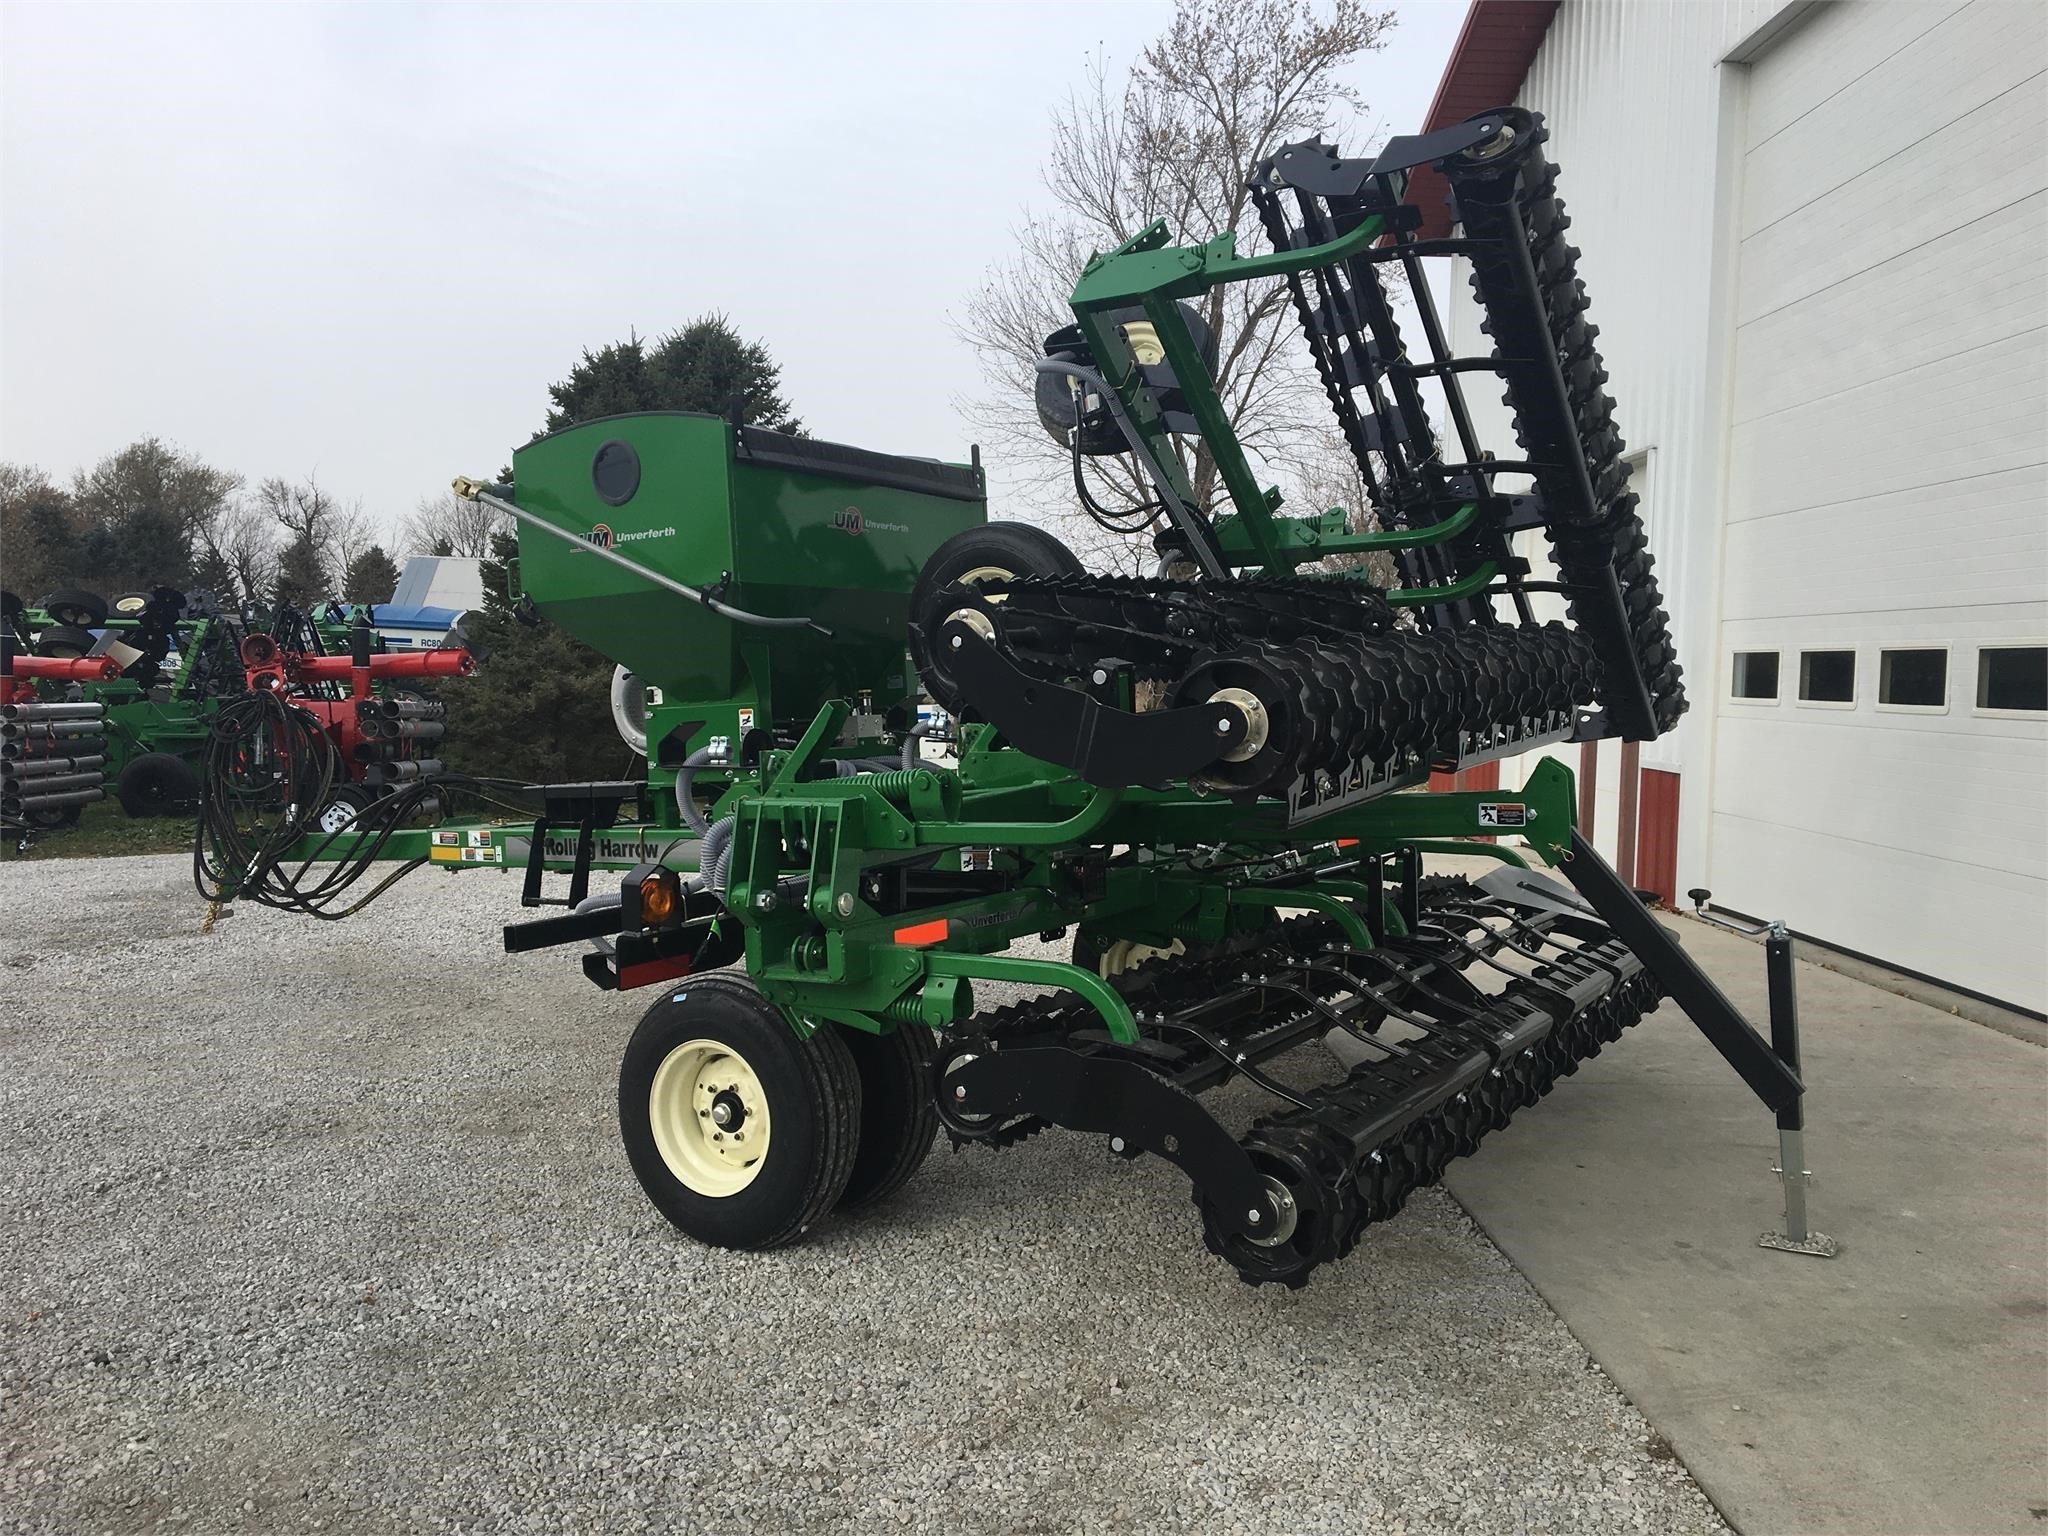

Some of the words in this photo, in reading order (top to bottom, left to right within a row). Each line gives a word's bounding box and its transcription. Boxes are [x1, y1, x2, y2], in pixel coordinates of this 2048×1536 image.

[616, 526, 676, 542] Unverferth
[865, 519, 909, 533] Unverferth
[545, 837, 596, 861] Rollig
